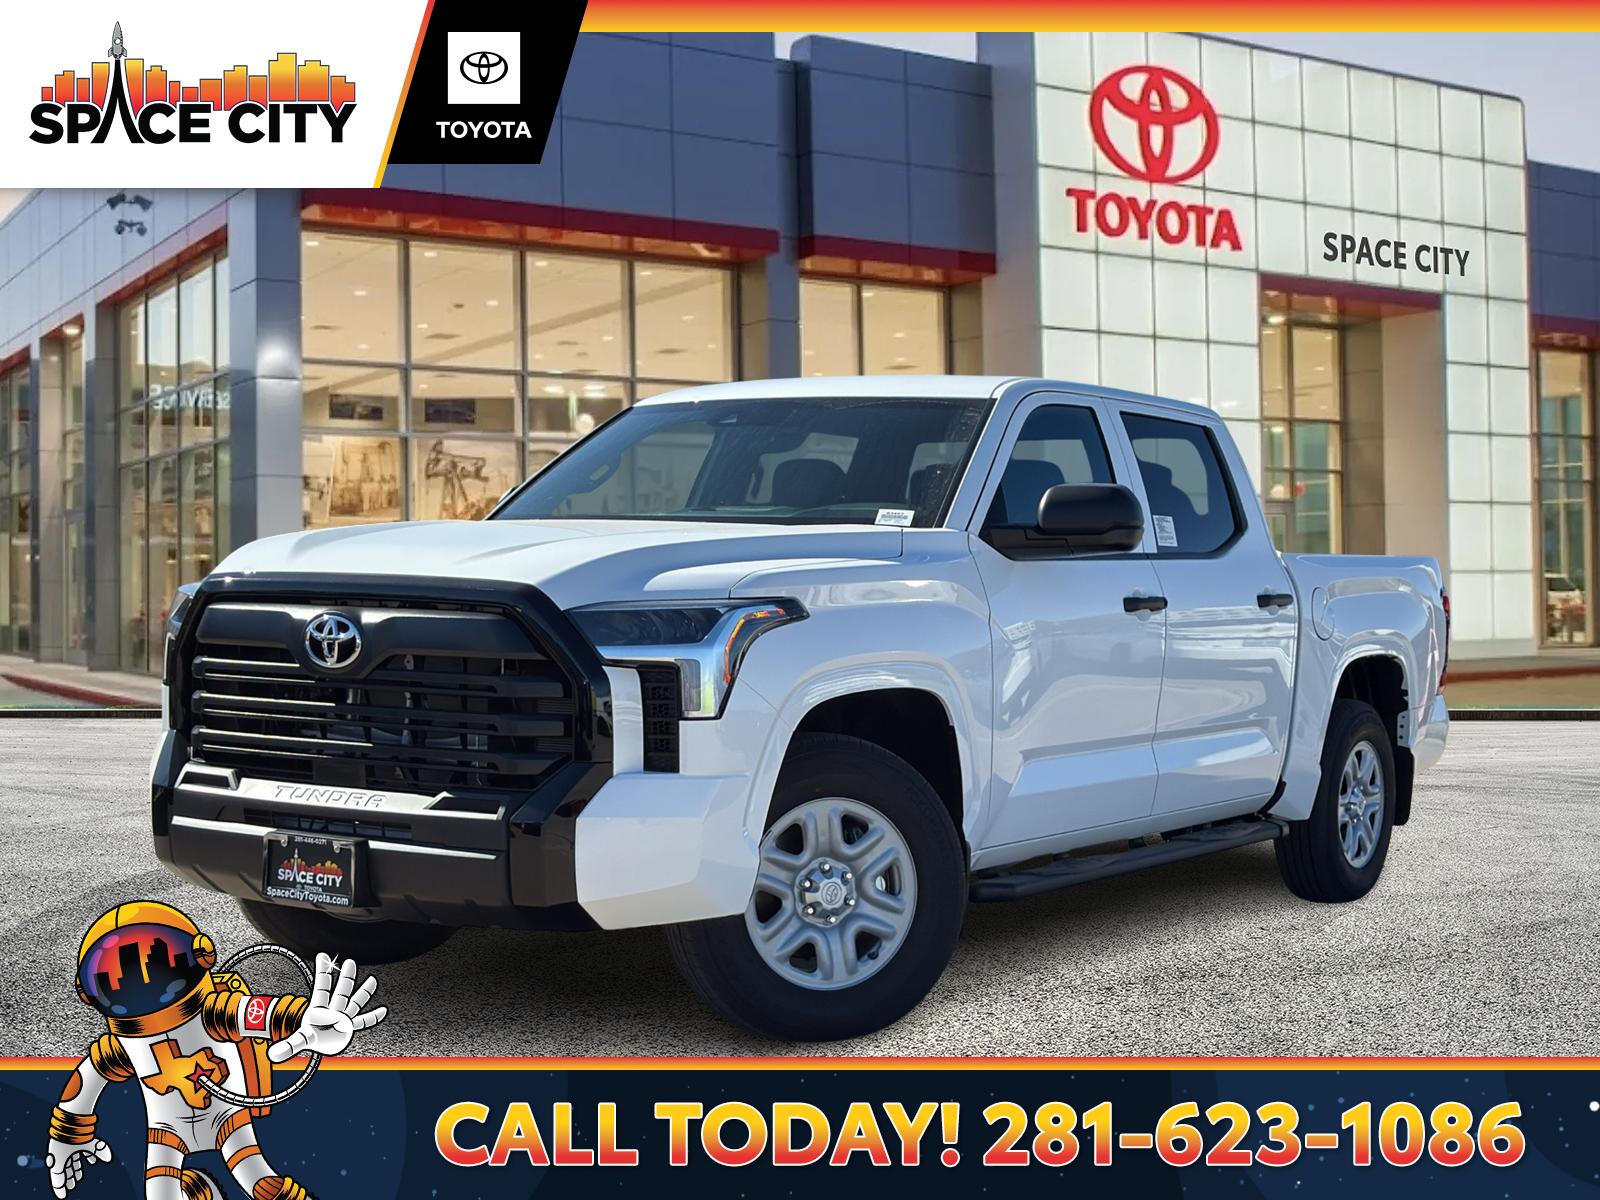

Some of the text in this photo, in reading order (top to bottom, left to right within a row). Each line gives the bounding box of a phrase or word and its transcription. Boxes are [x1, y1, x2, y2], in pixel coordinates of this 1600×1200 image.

[1066, 188, 1242, 251] TOYOTA
[1322, 231, 1470, 277] SPACE CITY
[275, 785, 387, 808] TUNDRA
[277, 868, 343, 887] SPACE CITY
[266, 886, 349, 906] SpaceCityToyota.com
